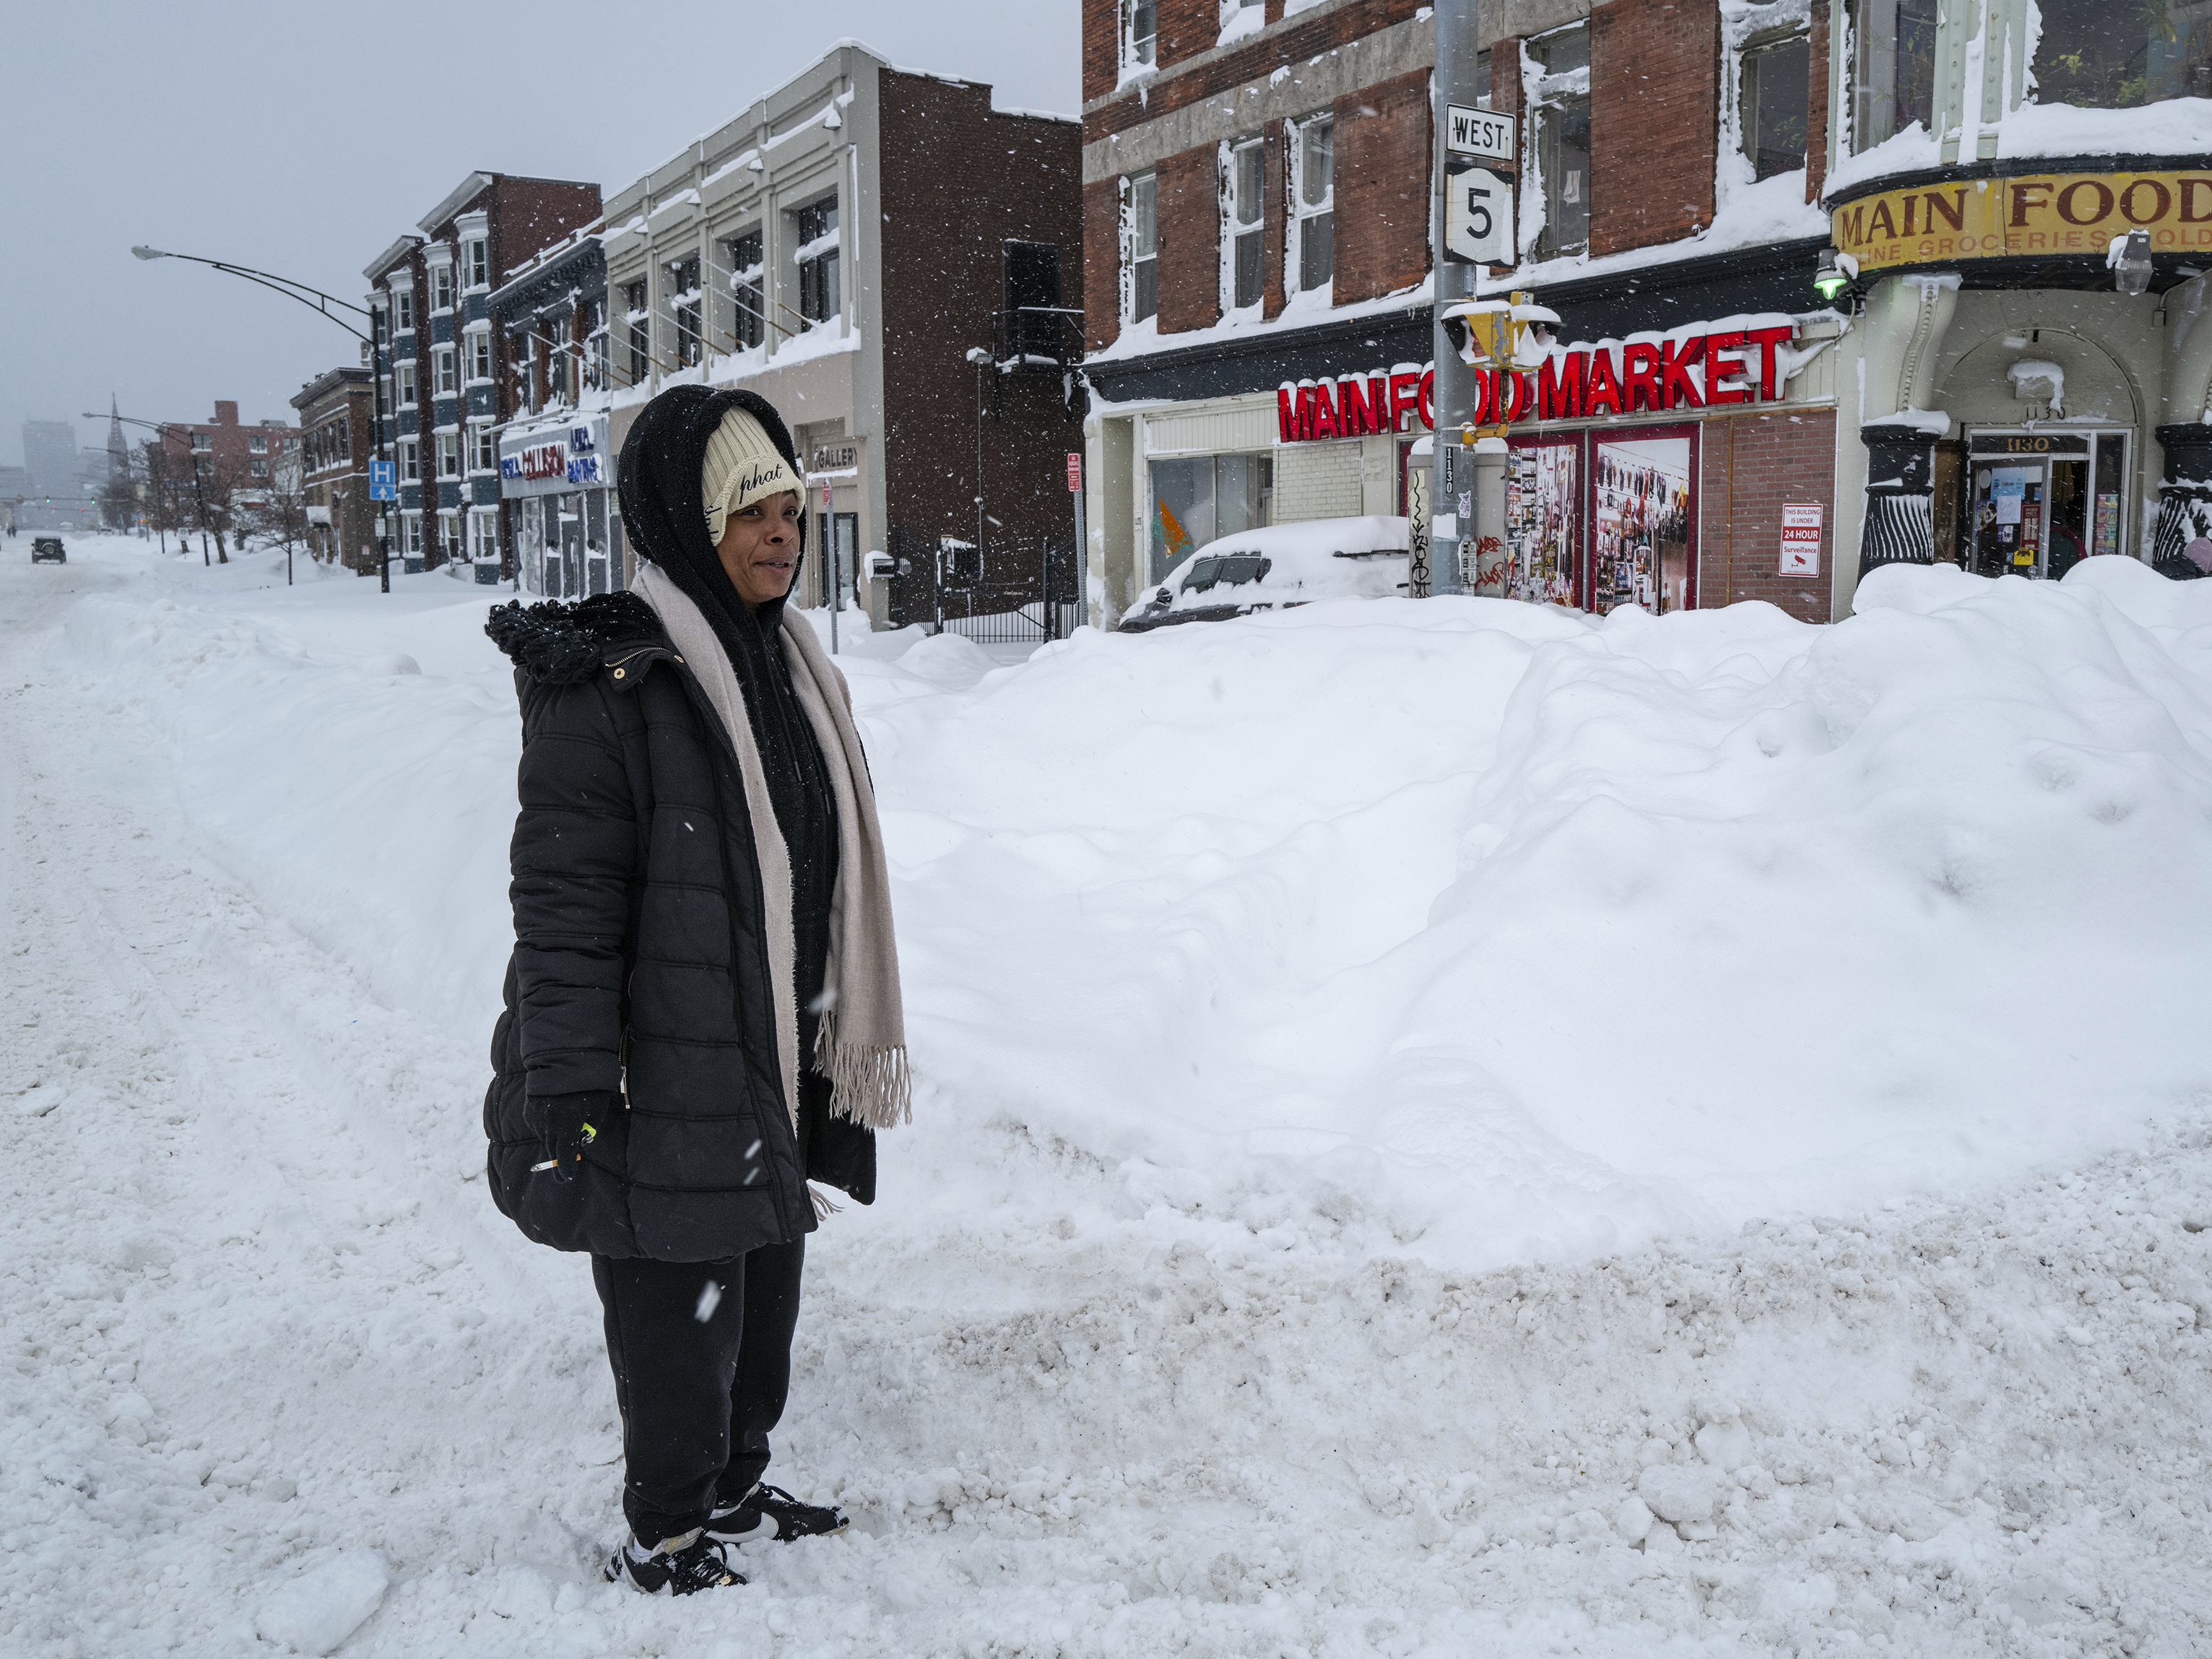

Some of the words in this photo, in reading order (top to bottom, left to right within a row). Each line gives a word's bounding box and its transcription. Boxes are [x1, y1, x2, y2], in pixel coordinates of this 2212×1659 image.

[1454, 116, 1504, 150] WEST
[1466, 187, 1492, 240] 5
[1841, 189, 1969, 251] MAIN
[2008, 178, 2212, 228] FOOD
[1918, 230, 2108, 256] GROCERIES
[1278, 376, 1383, 443] MAIN
[1538, 325, 1793, 420] MARKET
[2026, 406, 2065, 420] 1130
[2008, 437, 2050, 452] 1130
[375, 463, 390, 483] H
[739, 464, 783, 505] phat
[1784, 530, 1795, 539] 24
[1795, 530, 1818, 540] HOUR
